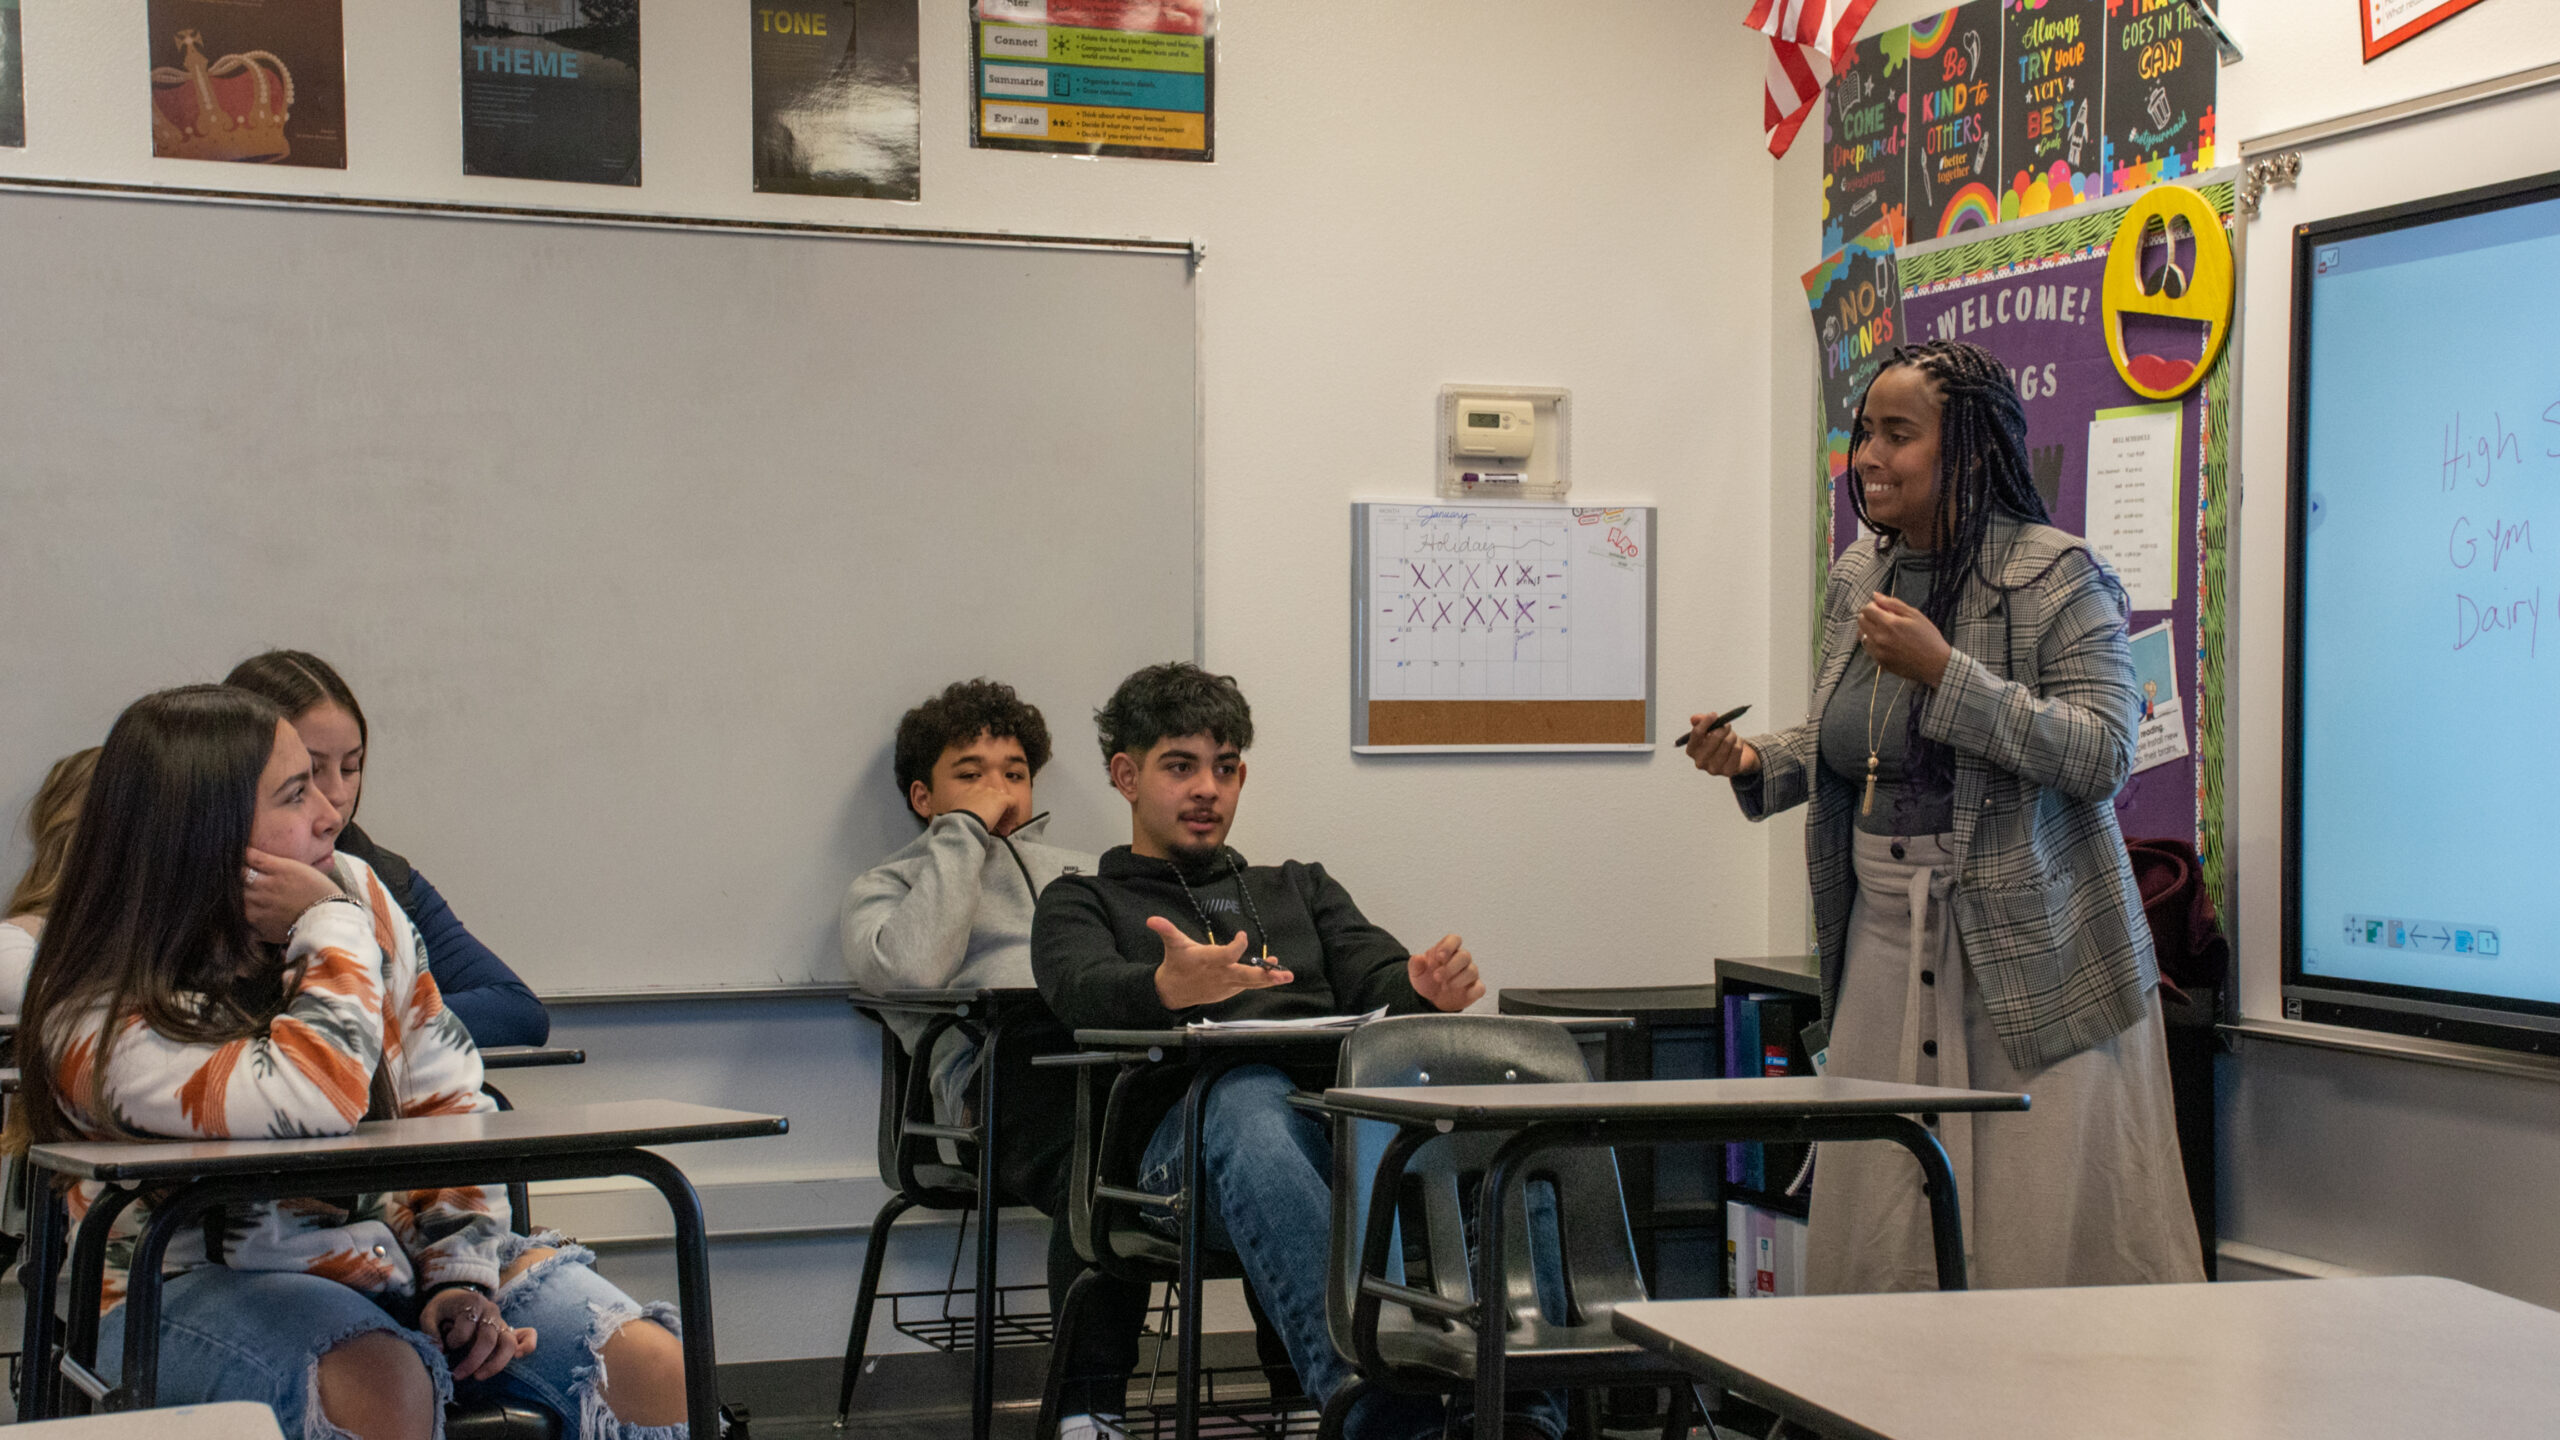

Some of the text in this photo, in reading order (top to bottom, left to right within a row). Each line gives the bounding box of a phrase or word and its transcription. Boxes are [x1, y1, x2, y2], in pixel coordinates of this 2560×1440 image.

[759, 9, 828, 36] TONE
[994, 35, 1038, 47] Connect
[2022, 14, 2081, 49] Always
[2122, 2, 2198, 51] GOES IN TH
[471, 45, 579, 79] THEME
[1942, 47, 1967, 82] Be
[2018, 47, 2052, 84] TRY
[2138, 37, 2182, 80] CAN
[988, 74, 1045, 87] Summarize
[994, 112, 1040, 126] Evaluate
[1922, 80, 1989, 124] KIND to
[2027, 99, 2075, 139] BEST
[1844, 102, 1885, 141] COME
[1927, 113, 1982, 155] OTHERS
[1937, 166, 1970, 184] together
[1839, 280, 1876, 331] NO
[2442, 410, 2522, 492] High
[1416, 505, 1477, 527] January
[1414, 531, 1497, 559] Holiday
[2449, 516, 2532, 572] Gym
[2453, 585, 2540, 659] Dairy
